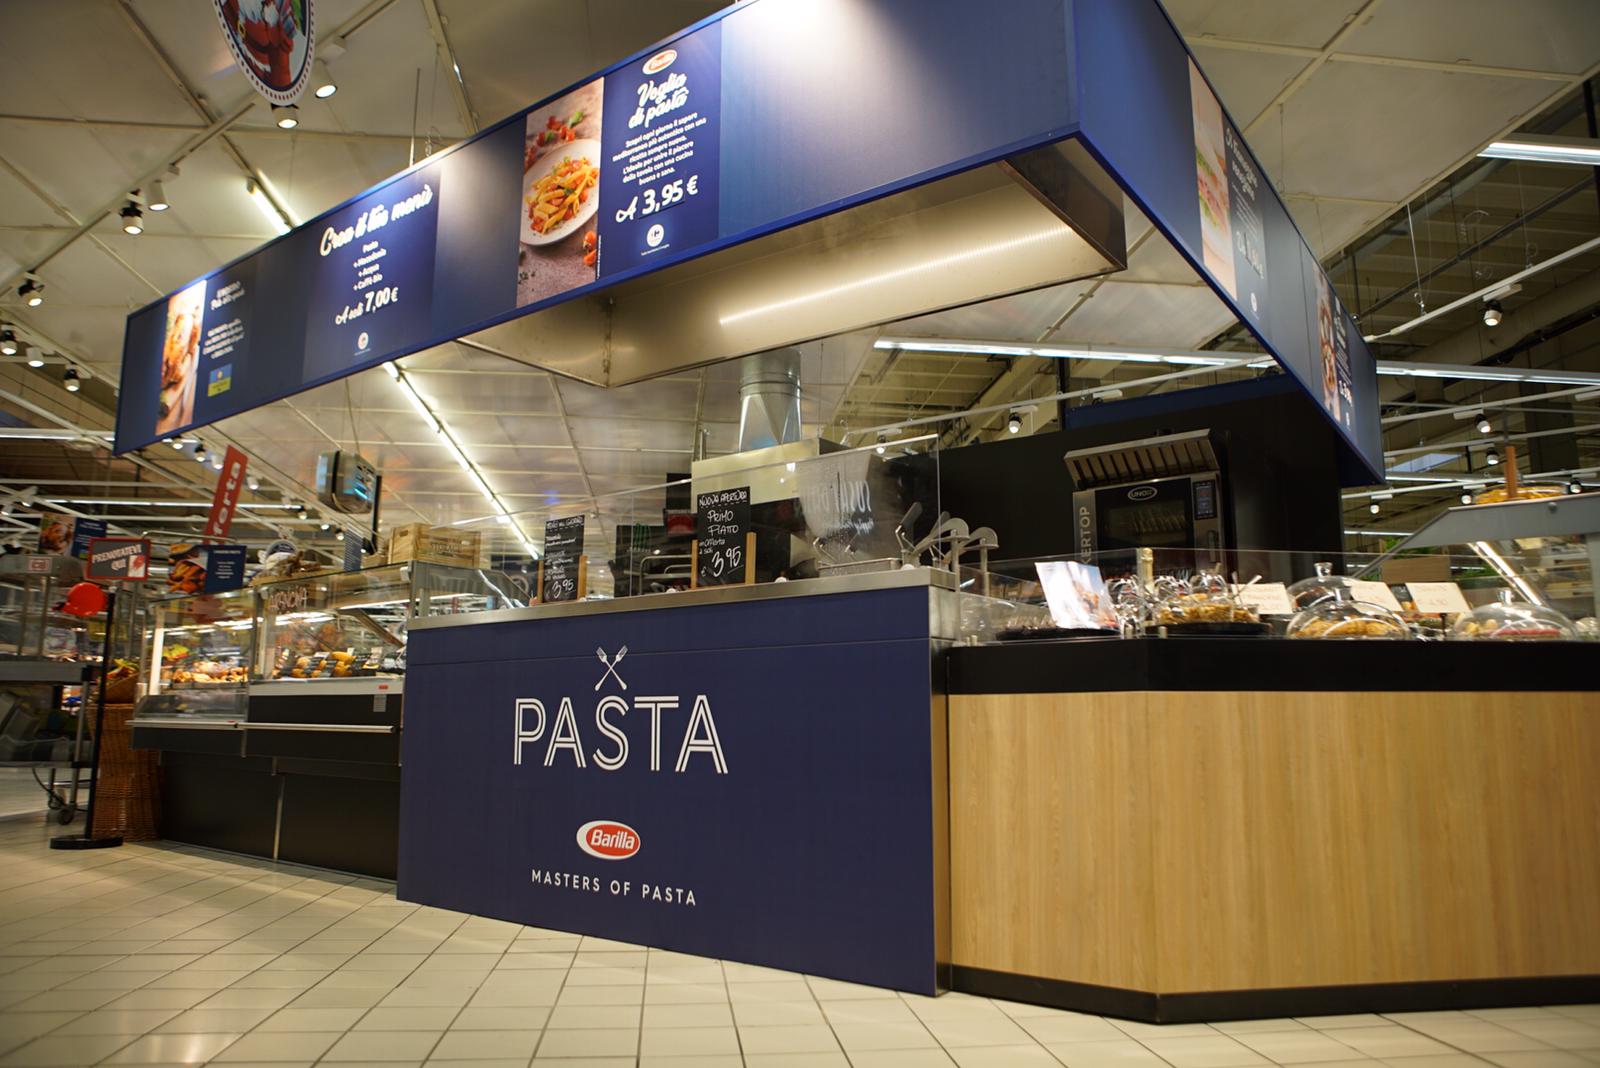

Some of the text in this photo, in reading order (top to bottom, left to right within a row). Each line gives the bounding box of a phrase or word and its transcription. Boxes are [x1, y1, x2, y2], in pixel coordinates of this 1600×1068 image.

[637, 73, 687, 107] Voglia
[628, 87, 689, 129] di pasta
[616, 175, 698, 222] A 3,95 €
[320, 227, 355, 256] Crea
[391, 184, 433, 221] menù
[365, 287, 390, 313] 7,00
[391, 287, 398, 302] €
[707, 509, 734, 522] PRIMO
[707, 524, 739, 536] PIATTO
[513, 694, 729, 774] PASTA
[590, 829, 635, 850] Barilla
[532, 869, 696, 906] MASTERS OF PASTA
